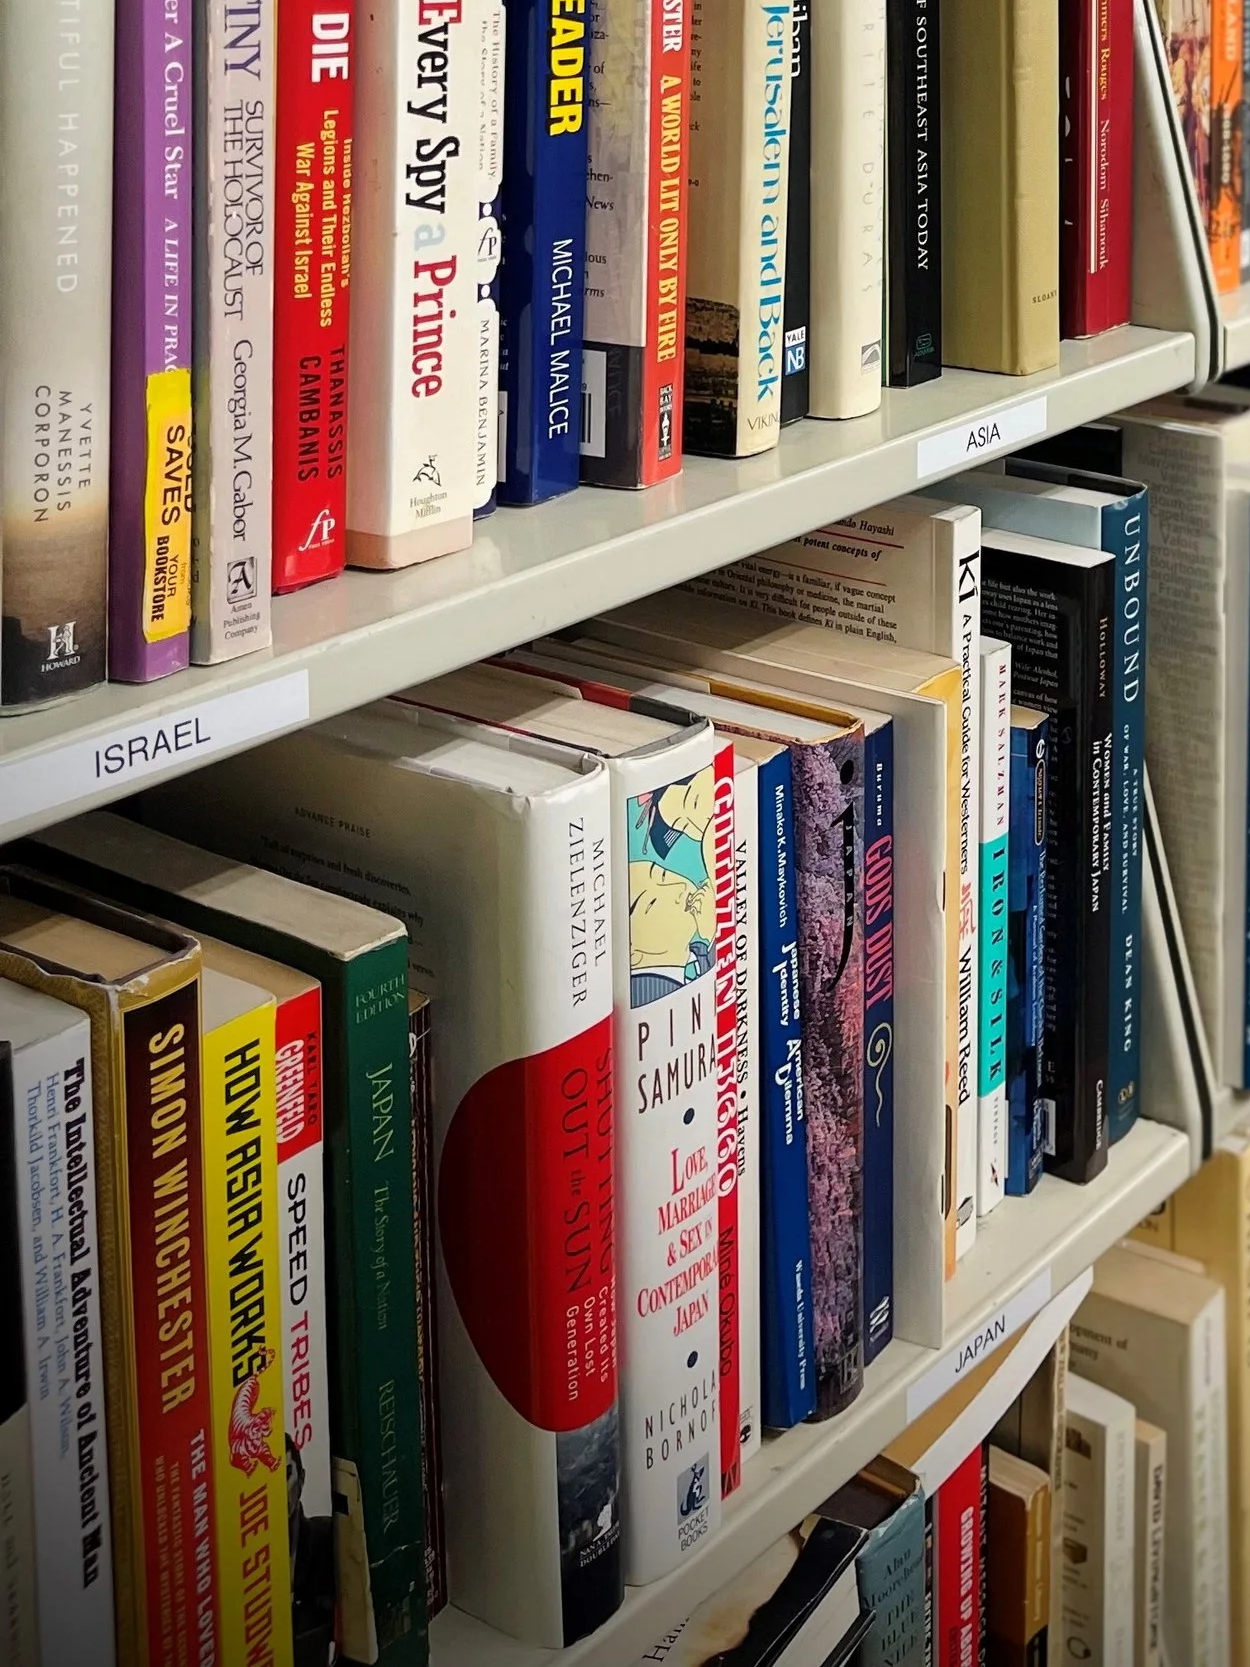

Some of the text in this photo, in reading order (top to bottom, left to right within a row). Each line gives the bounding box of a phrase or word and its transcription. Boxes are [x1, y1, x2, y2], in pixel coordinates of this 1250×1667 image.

[163, 61, 184, 136] Cruel
[164, 25, 183, 53] A
[311, 13, 350, 83] DIE
[914, 9, 928, 141] SOUTHEAST
[1100, 48, 1110, 100] Rouges
[56, 113, 80, 294] HAPPENED
[163, 146, 183, 200] Star
[222, 104, 245, 321] THE HOLOCAUST
[244, 100, 265, 277] SURVIVOR OF
[405, 137, 460, 214] Spy
[756, 3, 792, 402] Jerusalem and Back
[916, 148, 930, 195] ASIA
[1099, 120, 1109, 190] Norodom
[291, 142, 316, 299] War Against Israel
[319, 109, 338, 327] Legions and Their Endless
[657, 75, 680, 363] A WORLD LIT ONLY BY FIRE
[916, 198, 930, 271] TODAY
[1100, 199, 1109, 270] Sihanouk
[412, 256, 456, 399] Prince
[547, 238, 574, 439] MICHAEL MALICE
[34, 385, 50, 522] CORPORON
[56, 389, 73, 512] MANESSIS
[78, 403, 93, 490] YVETTE
[229, 339, 254, 542] Georgia Gabor
[297, 355, 322, 482] CAMBANIS
[326, 345, 345, 479] THANASSIS
[962, 422, 1001, 452] ASIA
[159, 424, 183, 526] SAVES
[150, 535, 170, 622] BOOKSTORE
[165, 553, 180, 598] YOUR
[1122, 513, 1142, 705] UNBOUND
[95, 718, 211, 778] ISRAEL
[959, 633, 973, 875] Practical Guide Westerners
[569, 817, 587, 1009] ZIELENZIGER
[865, 834, 892, 926] GODS
[865, 933, 894, 1011] DUST
[955, 946, 973, 1107] William Reed
[988, 848, 1006, 1083] IRON SILK
[365, 1063, 394, 1163] JAPAN
[64, 1058, 92, 1398] The Intellectual Adventure
[148, 1023, 198, 1415] SIMON WINCHESTER
[223, 1039, 267, 1388] HOW ASIA WORKS
[561, 1067, 592, 1296] OUT the SUN
[287, 1172, 313, 1451] SPEED TRIBES
[566, 1305, 581, 1401] Generation
[719, 1292, 736, 1377] Okubo
[955, 1316, 1005, 1373] JAPAN
[678, 1508, 709, 1540] POCKET
